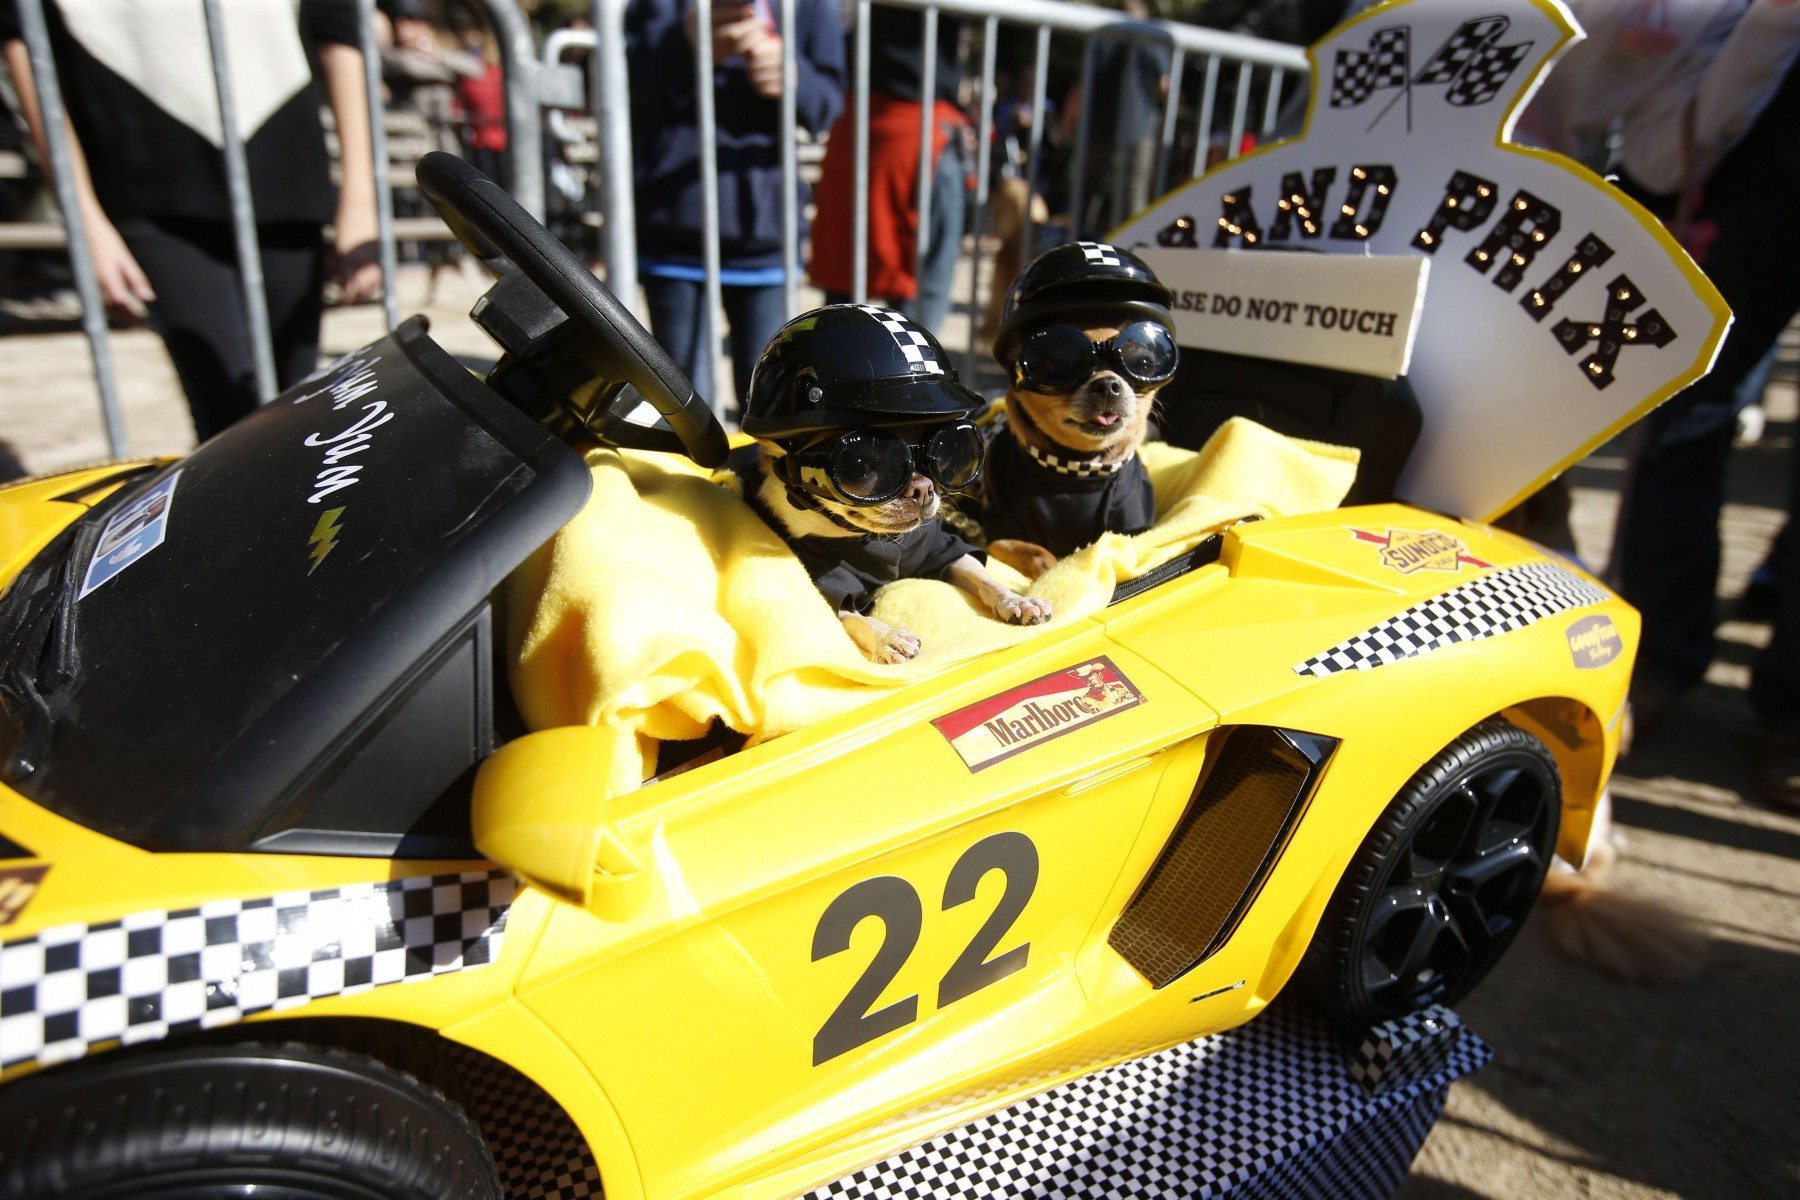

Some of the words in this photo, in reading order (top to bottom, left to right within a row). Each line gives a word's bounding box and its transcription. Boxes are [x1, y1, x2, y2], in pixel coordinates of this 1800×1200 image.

[1134, 165, 1397, 248] AND
[1411, 169, 1678, 391] PRIX
[1211, 294, 1242, 317] DO
[1246, 298, 1299, 326] NOT
[1304, 304, 1398, 337] TOUCH
[811, 831, 1040, 1068] 22
